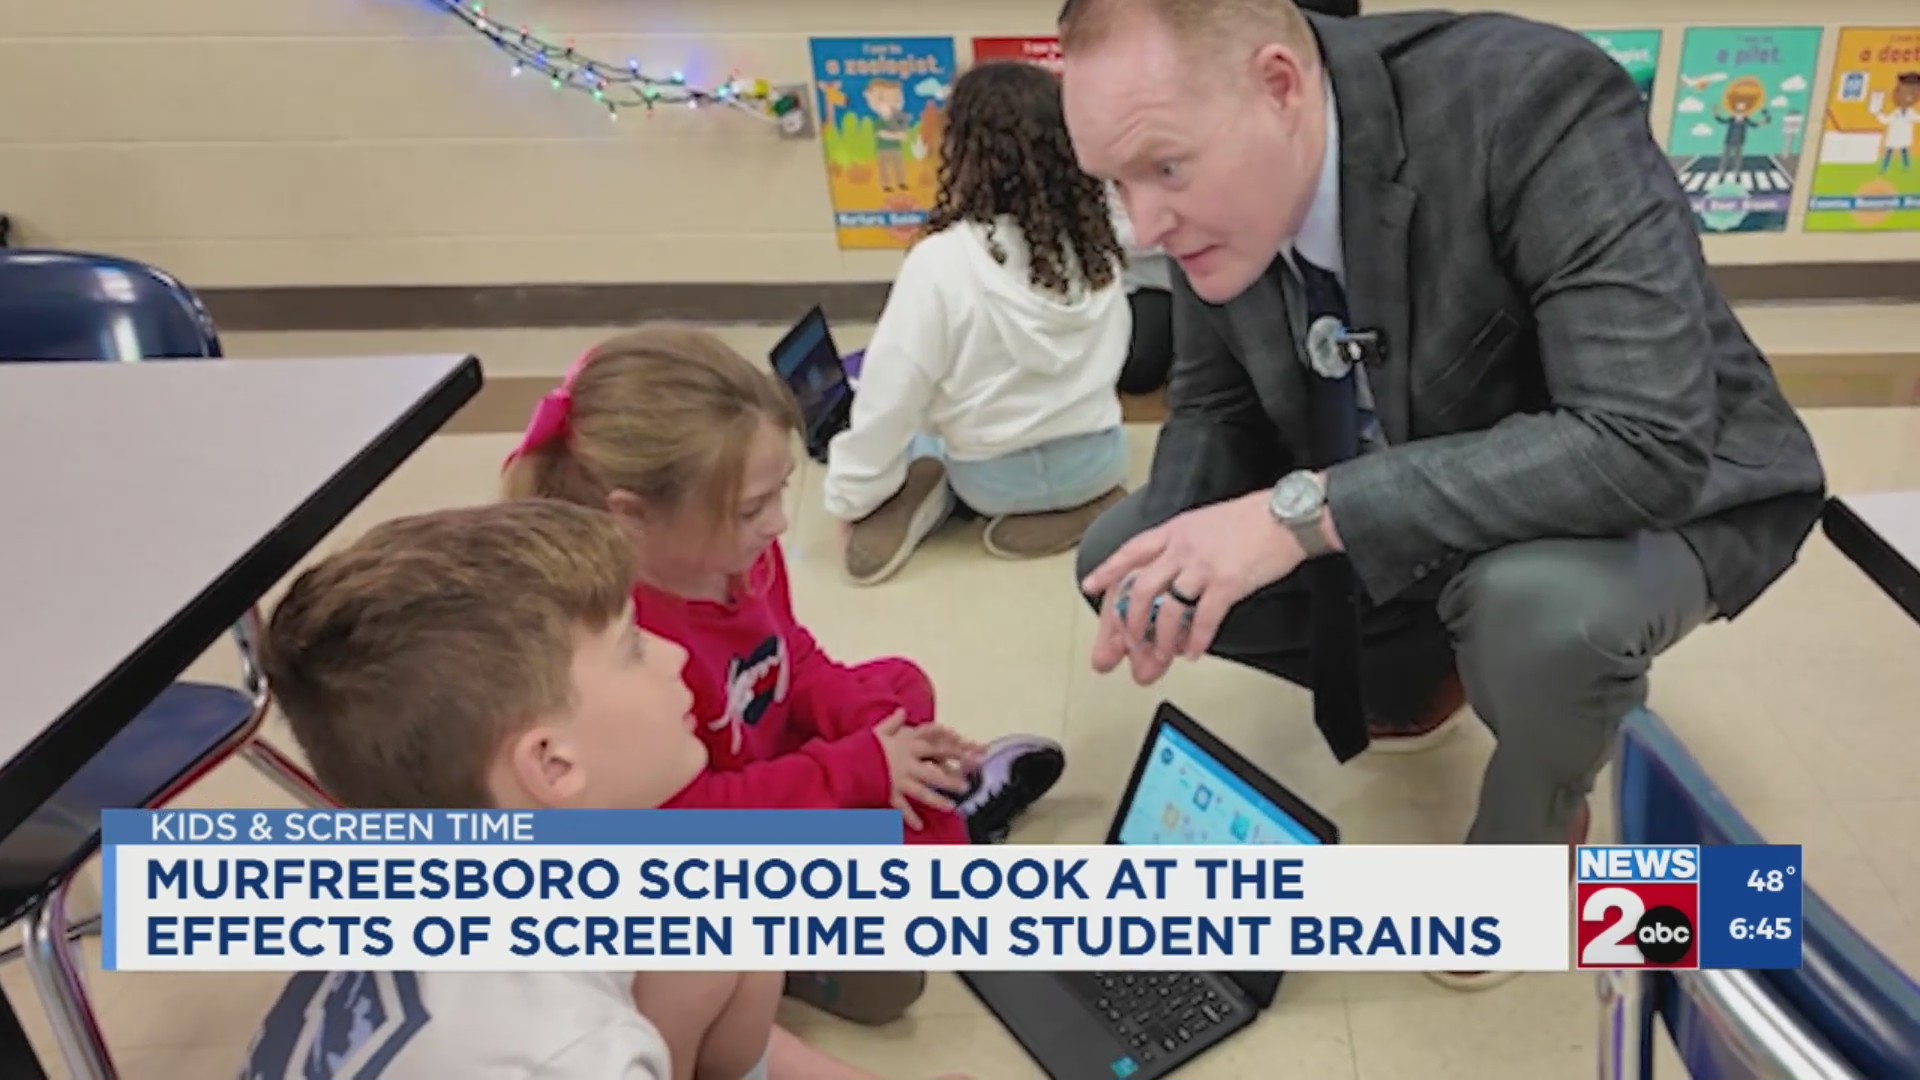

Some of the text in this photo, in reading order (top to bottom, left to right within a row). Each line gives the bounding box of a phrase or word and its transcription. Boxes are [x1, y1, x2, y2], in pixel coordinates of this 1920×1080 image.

[1717, 49, 1729, 64] a
[1859, 49, 1872, 63] a
[825, 59, 840, 75] a
